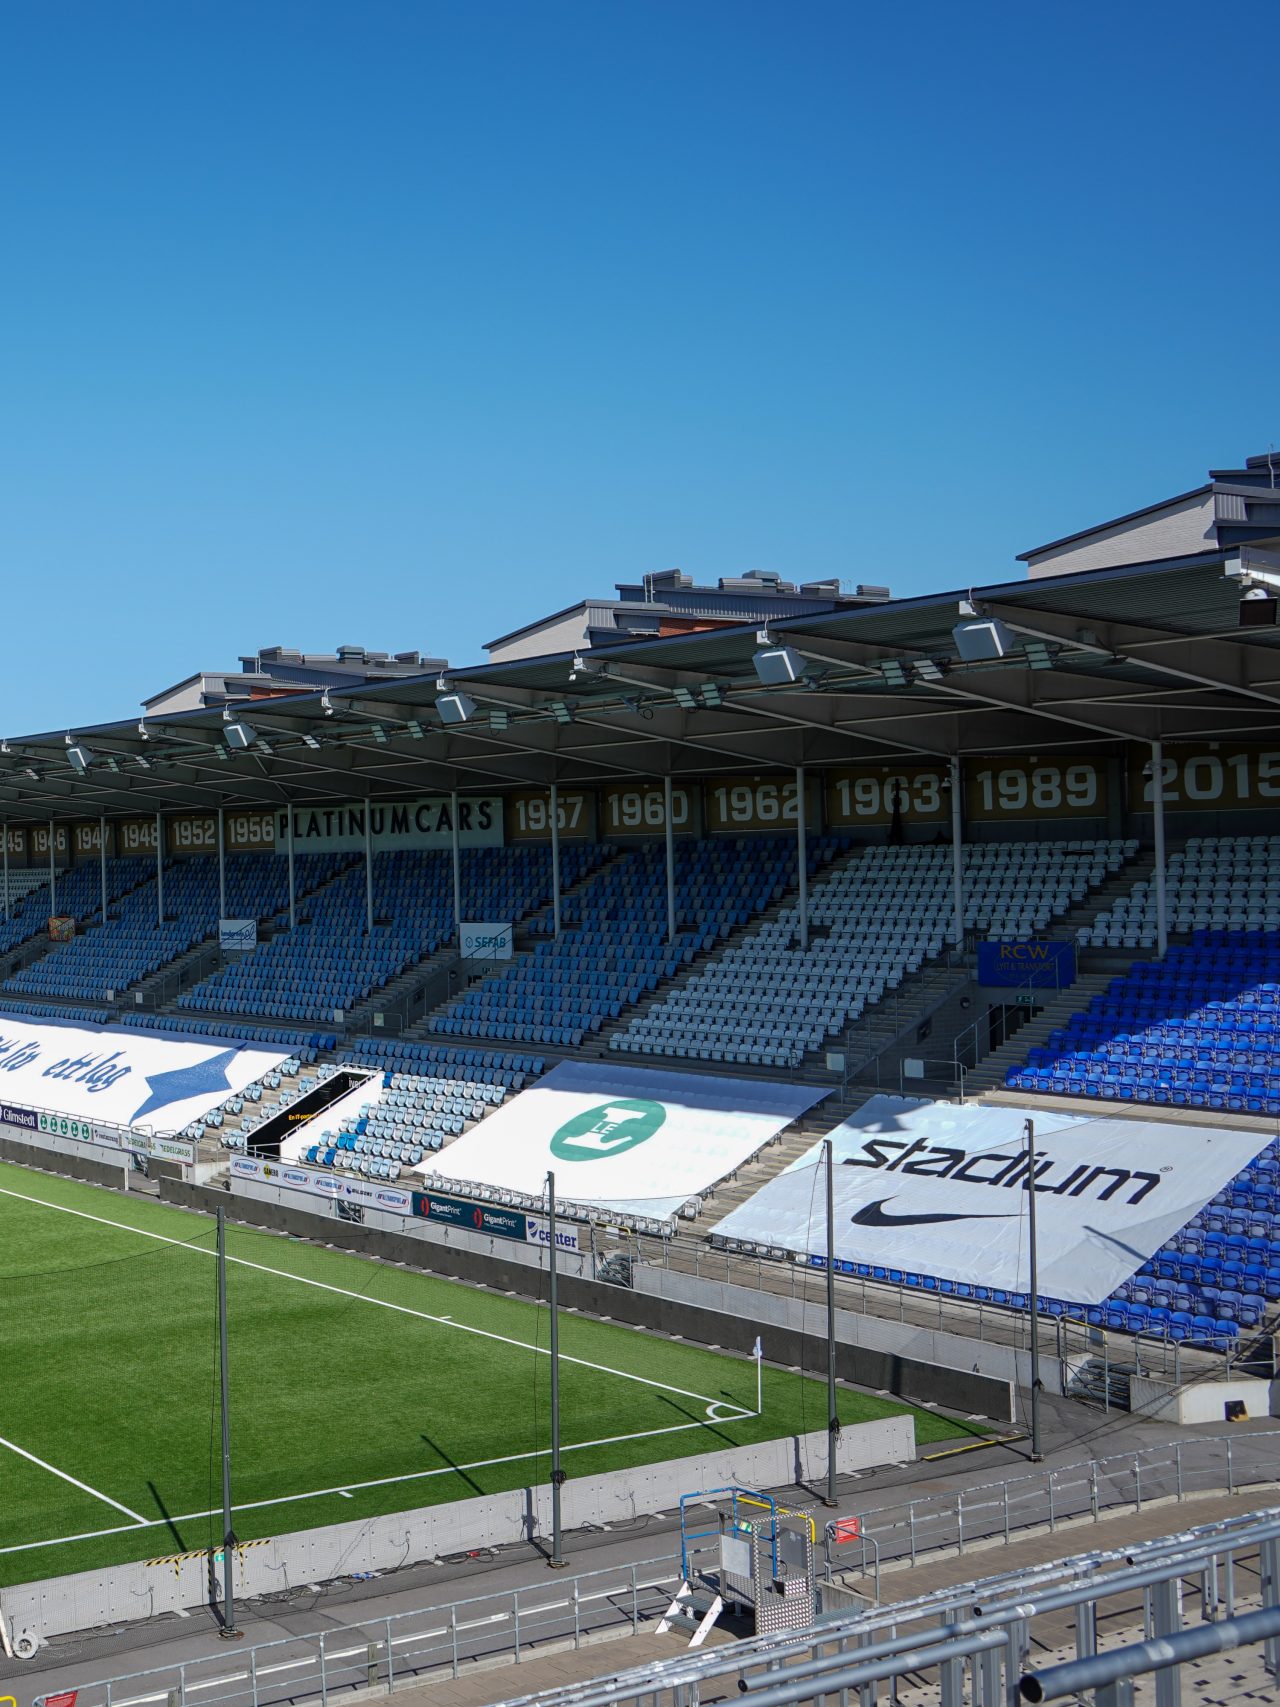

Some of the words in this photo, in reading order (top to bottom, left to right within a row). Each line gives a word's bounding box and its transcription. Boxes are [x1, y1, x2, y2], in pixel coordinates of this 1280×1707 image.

[976, 765, 1097, 811] 1989
[1143, 752, 1280, 802] 2015
[607, 789, 688, 827] 1960
[714, 783, 799, 822] 1962
[836, 773, 941, 817] 1963
[279, 800, 492, 839] PLATINUMCARS
[515, 796, 584, 831] 1957
[122, 822, 158, 848] 1948
[173, 819, 216, 846] 1952
[228, 815, 274, 844] 1956
[475, 936, 506, 948] SEFAB
[1000, 944, 1049, 960] RCW
[3, 1108, 35, 1127] Glimstedt
[842, 1137, 1161, 1205] stadium
[430, 1201, 461, 1216] GigantPrint
[483, 1213, 516, 1228] GigantPrint
[538, 1230, 577, 1248] center
